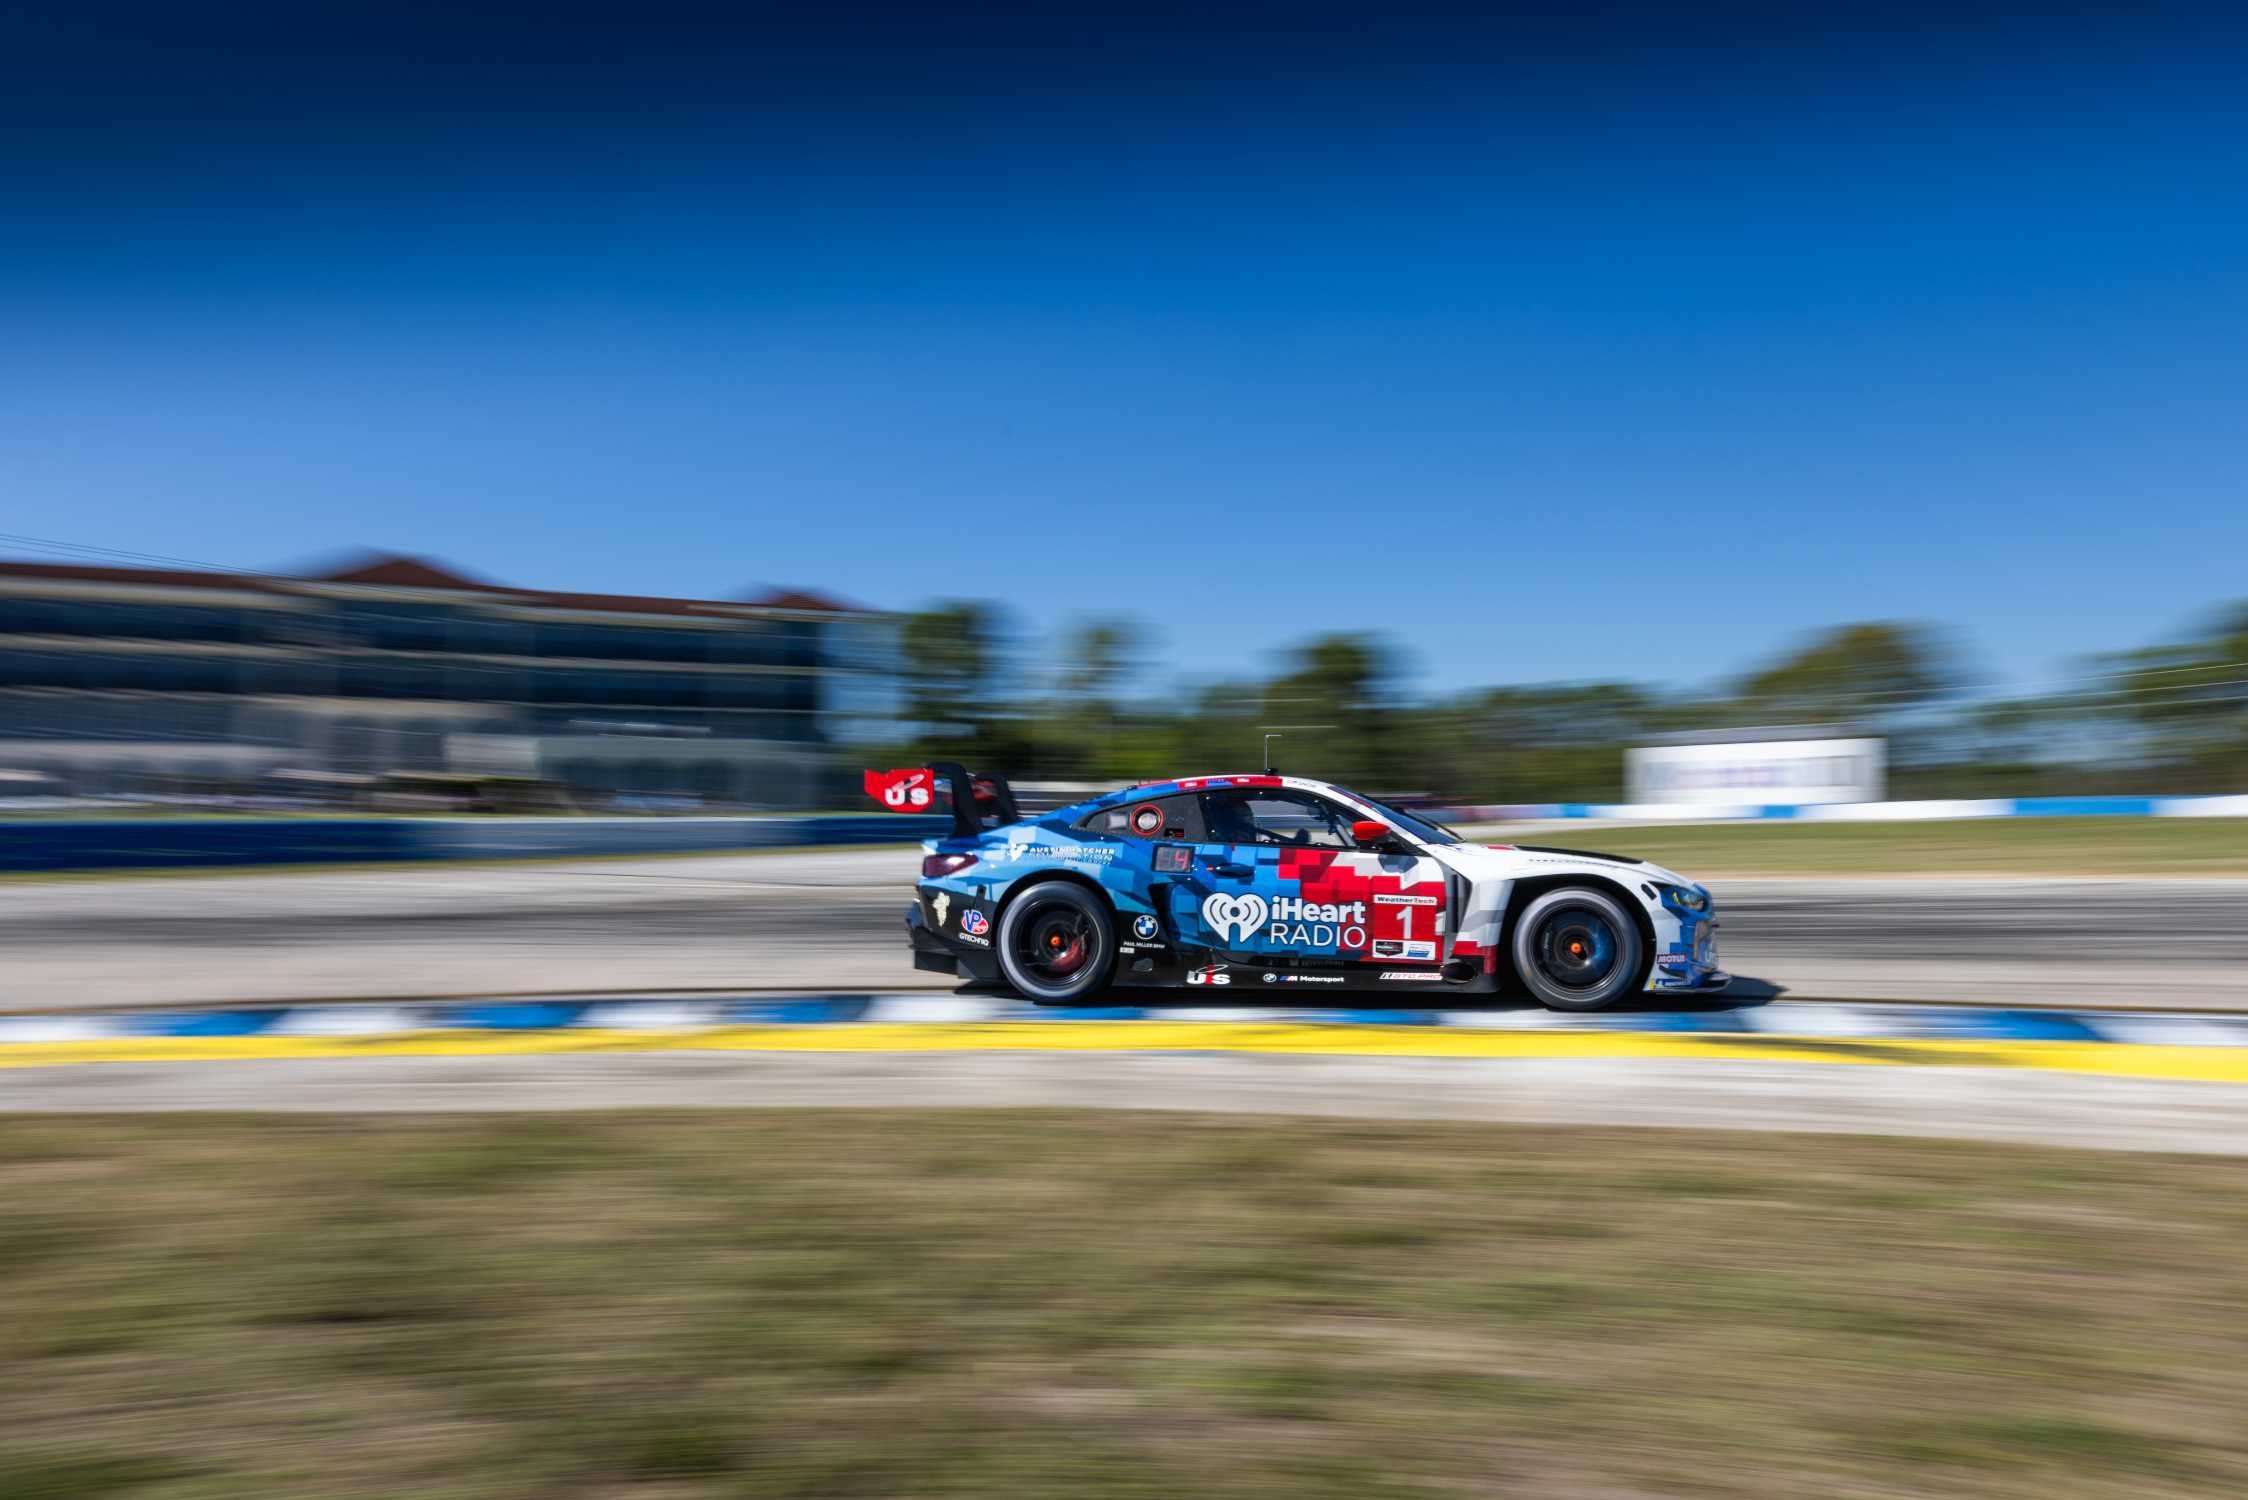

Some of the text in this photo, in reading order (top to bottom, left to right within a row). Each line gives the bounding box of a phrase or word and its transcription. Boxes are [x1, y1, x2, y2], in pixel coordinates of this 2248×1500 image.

[1271, 895, 1366, 924] iHeart
[1377, 896, 1435, 904] WeatherTech
[1270, 922, 1366, 948] RADIO
[1396, 905, 1413, 940] 1
[1300, 975, 1344, 983] Motorsport
